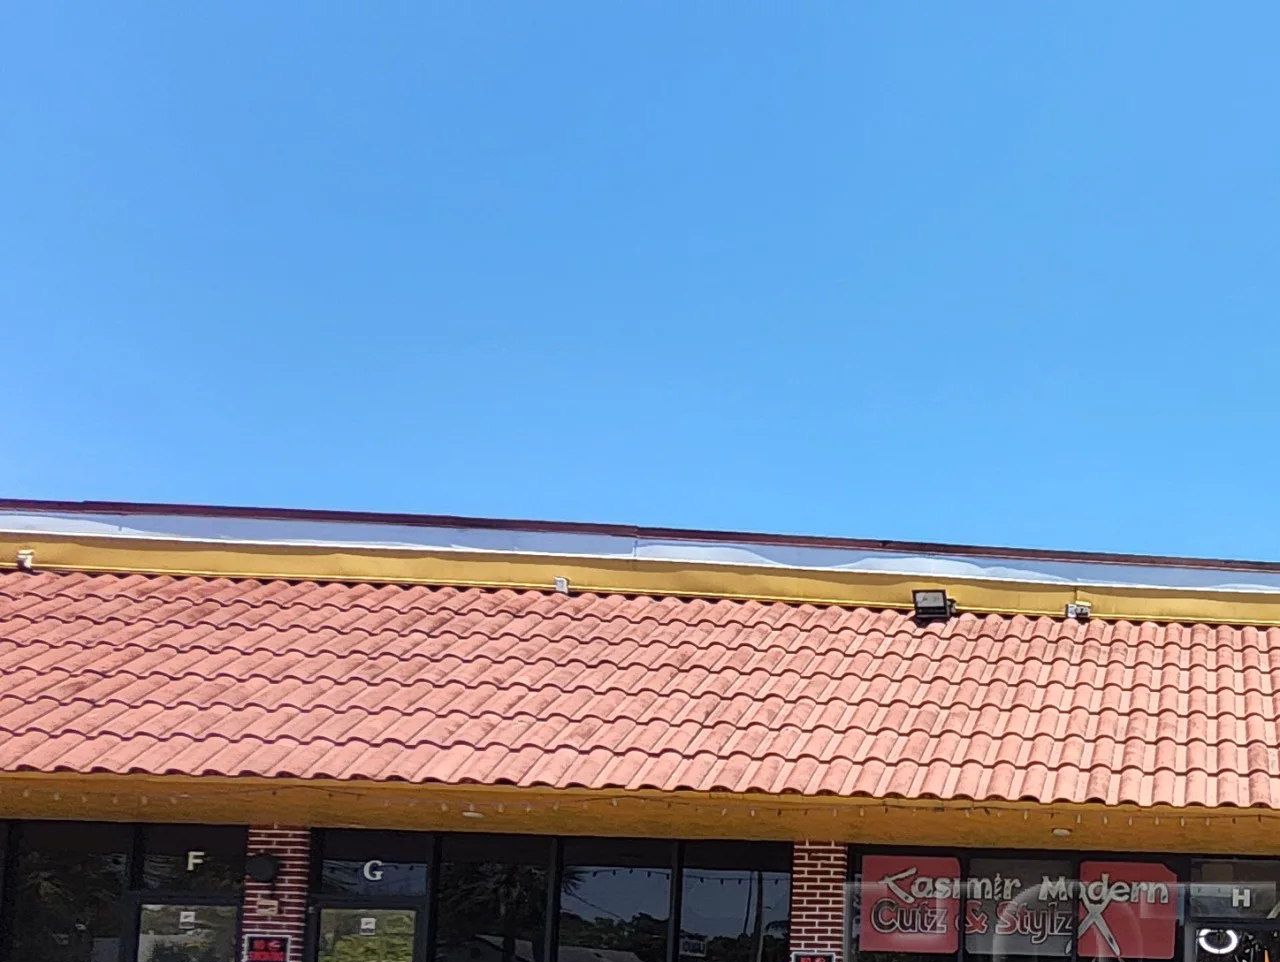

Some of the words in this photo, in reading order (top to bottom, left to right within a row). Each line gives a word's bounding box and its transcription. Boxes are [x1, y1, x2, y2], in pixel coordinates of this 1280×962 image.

[187, 850, 205, 871] F
[363, 860, 383, 881] G
[1232, 889, 1251, 907] H
[871, 897, 948, 934] Cutz
[956, 901, 988, 934] &
[996, 900, 1073, 943] Stylz
